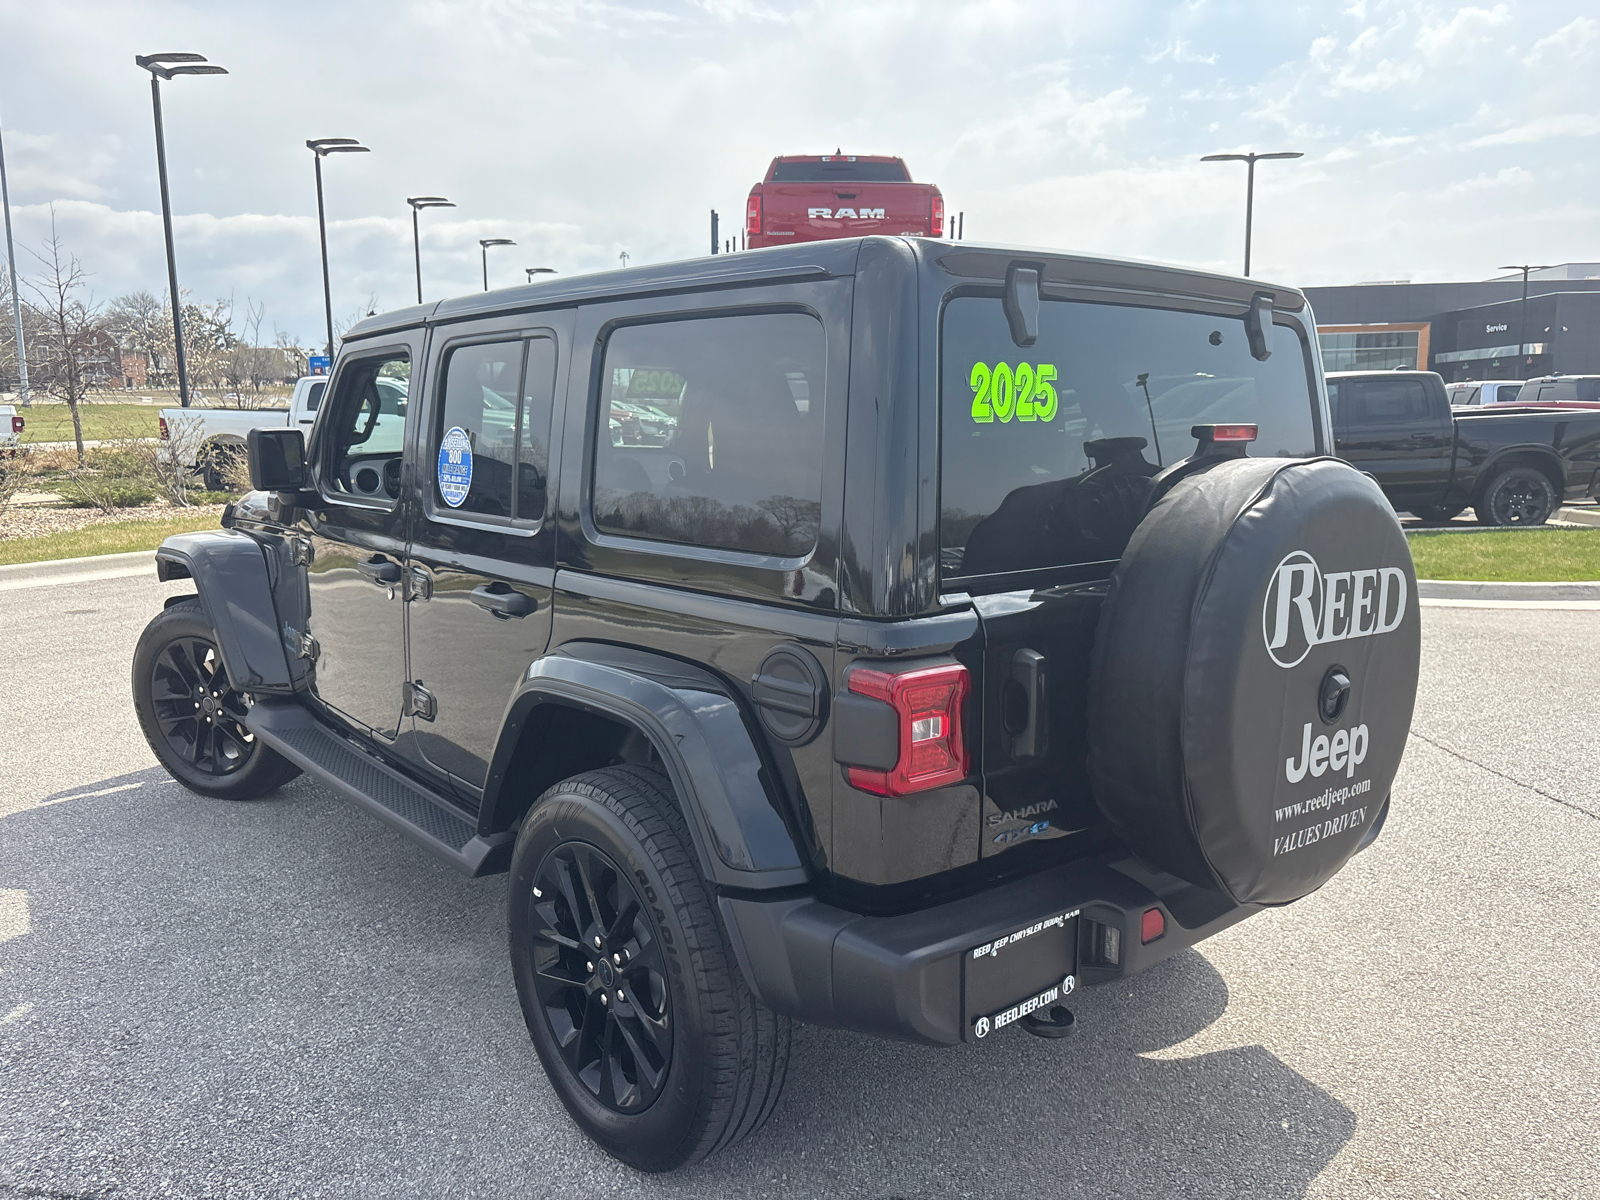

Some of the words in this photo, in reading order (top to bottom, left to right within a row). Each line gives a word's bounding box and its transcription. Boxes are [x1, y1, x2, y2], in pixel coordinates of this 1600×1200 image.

[808, 207, 886, 219] RAM
[1486, 323, 1508, 334] Service
[970, 362, 1058, 423] 2025
[442, 464, 453, 474] MILE
[453, 465, 468, 476] RANGE
[448, 449, 462, 464] 800
[1263, 550, 1407, 668] REED
[1286, 722, 1369, 784] Jeep
[986, 799, 1059, 827] SAHARA
[1275, 779, 1371, 823] www.reedjeep.com
[1273, 823, 1322, 857] VALUES
[1322, 806, 1368, 840] DRIVEN
[973, 943, 991, 959] REED
[992, 936, 1009, 950] JEEP
[1009, 922, 1043, 943] CHRYSLER
[994, 987, 1058, 1030] REEDJEEP.COM
